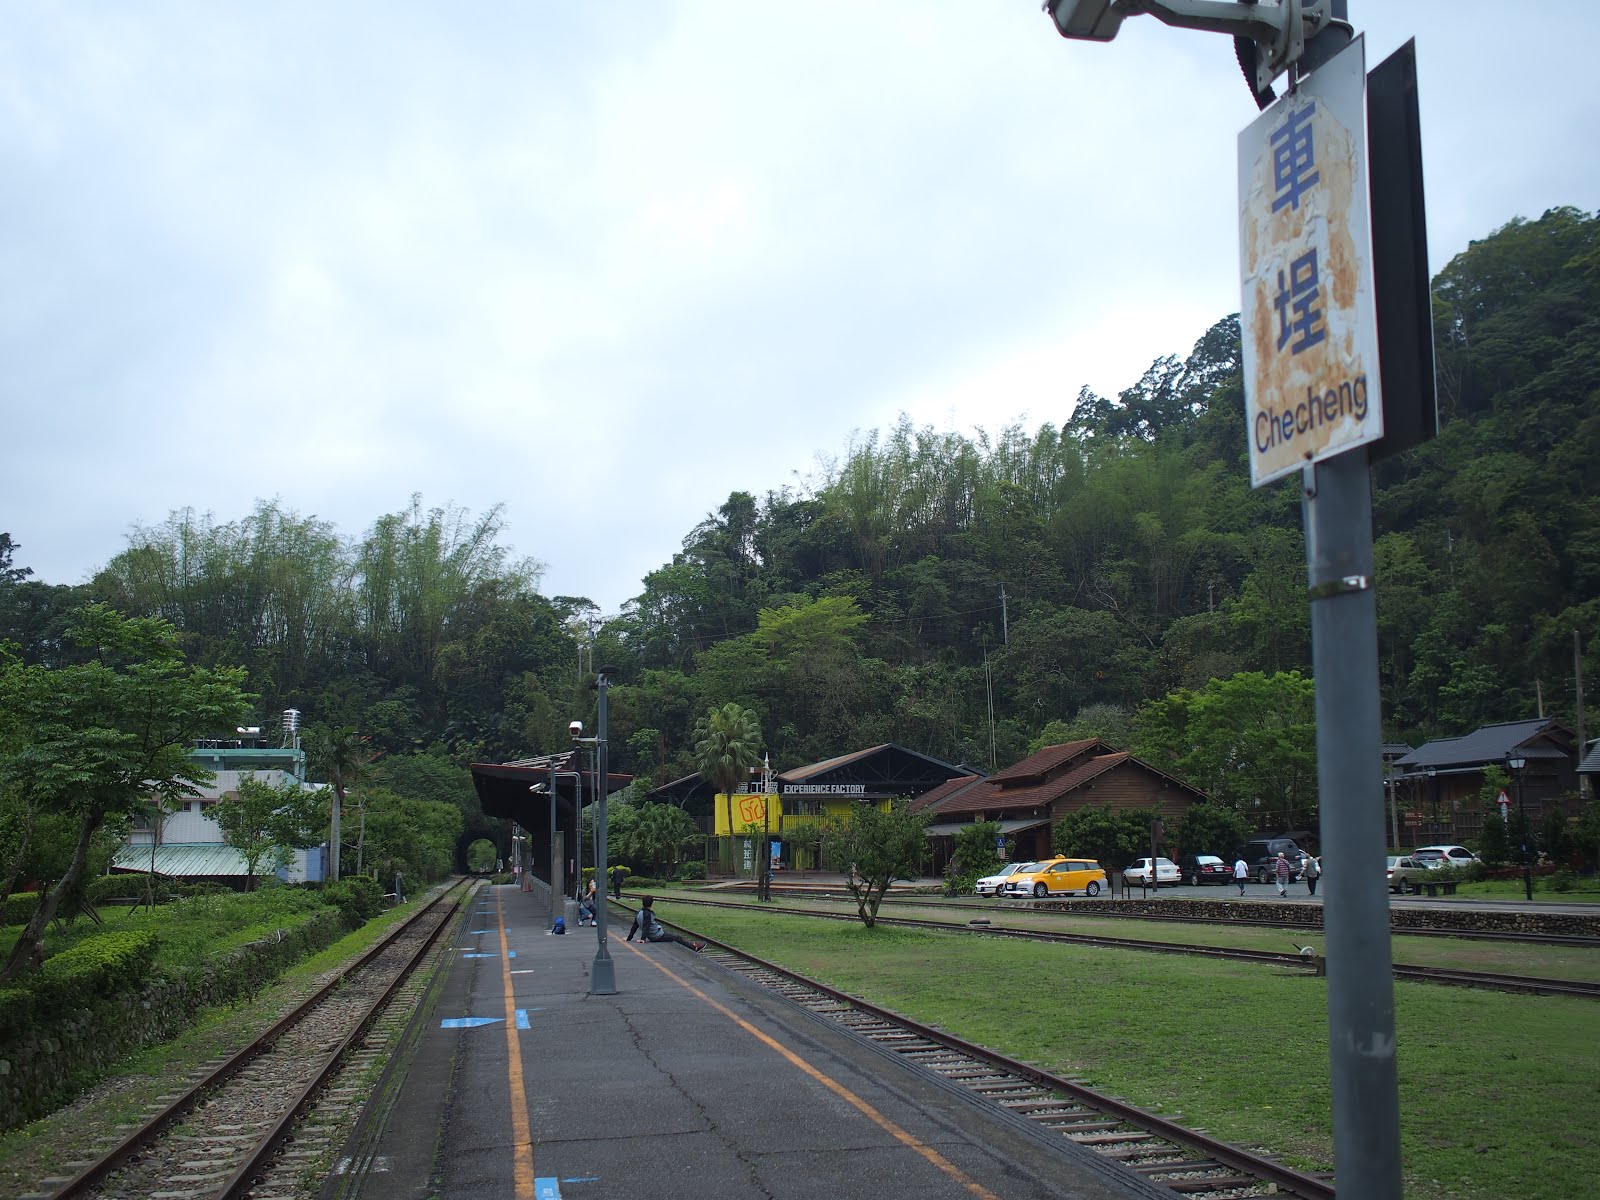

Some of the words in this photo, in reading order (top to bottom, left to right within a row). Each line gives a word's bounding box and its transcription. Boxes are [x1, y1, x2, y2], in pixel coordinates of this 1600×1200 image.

[1270, 101, 1325, 356] 車埕
[1255, 374, 1369, 453] Checheng
[783, 784, 830, 794] EXPERIENCE
[831, 784, 866, 794] FACTORY
